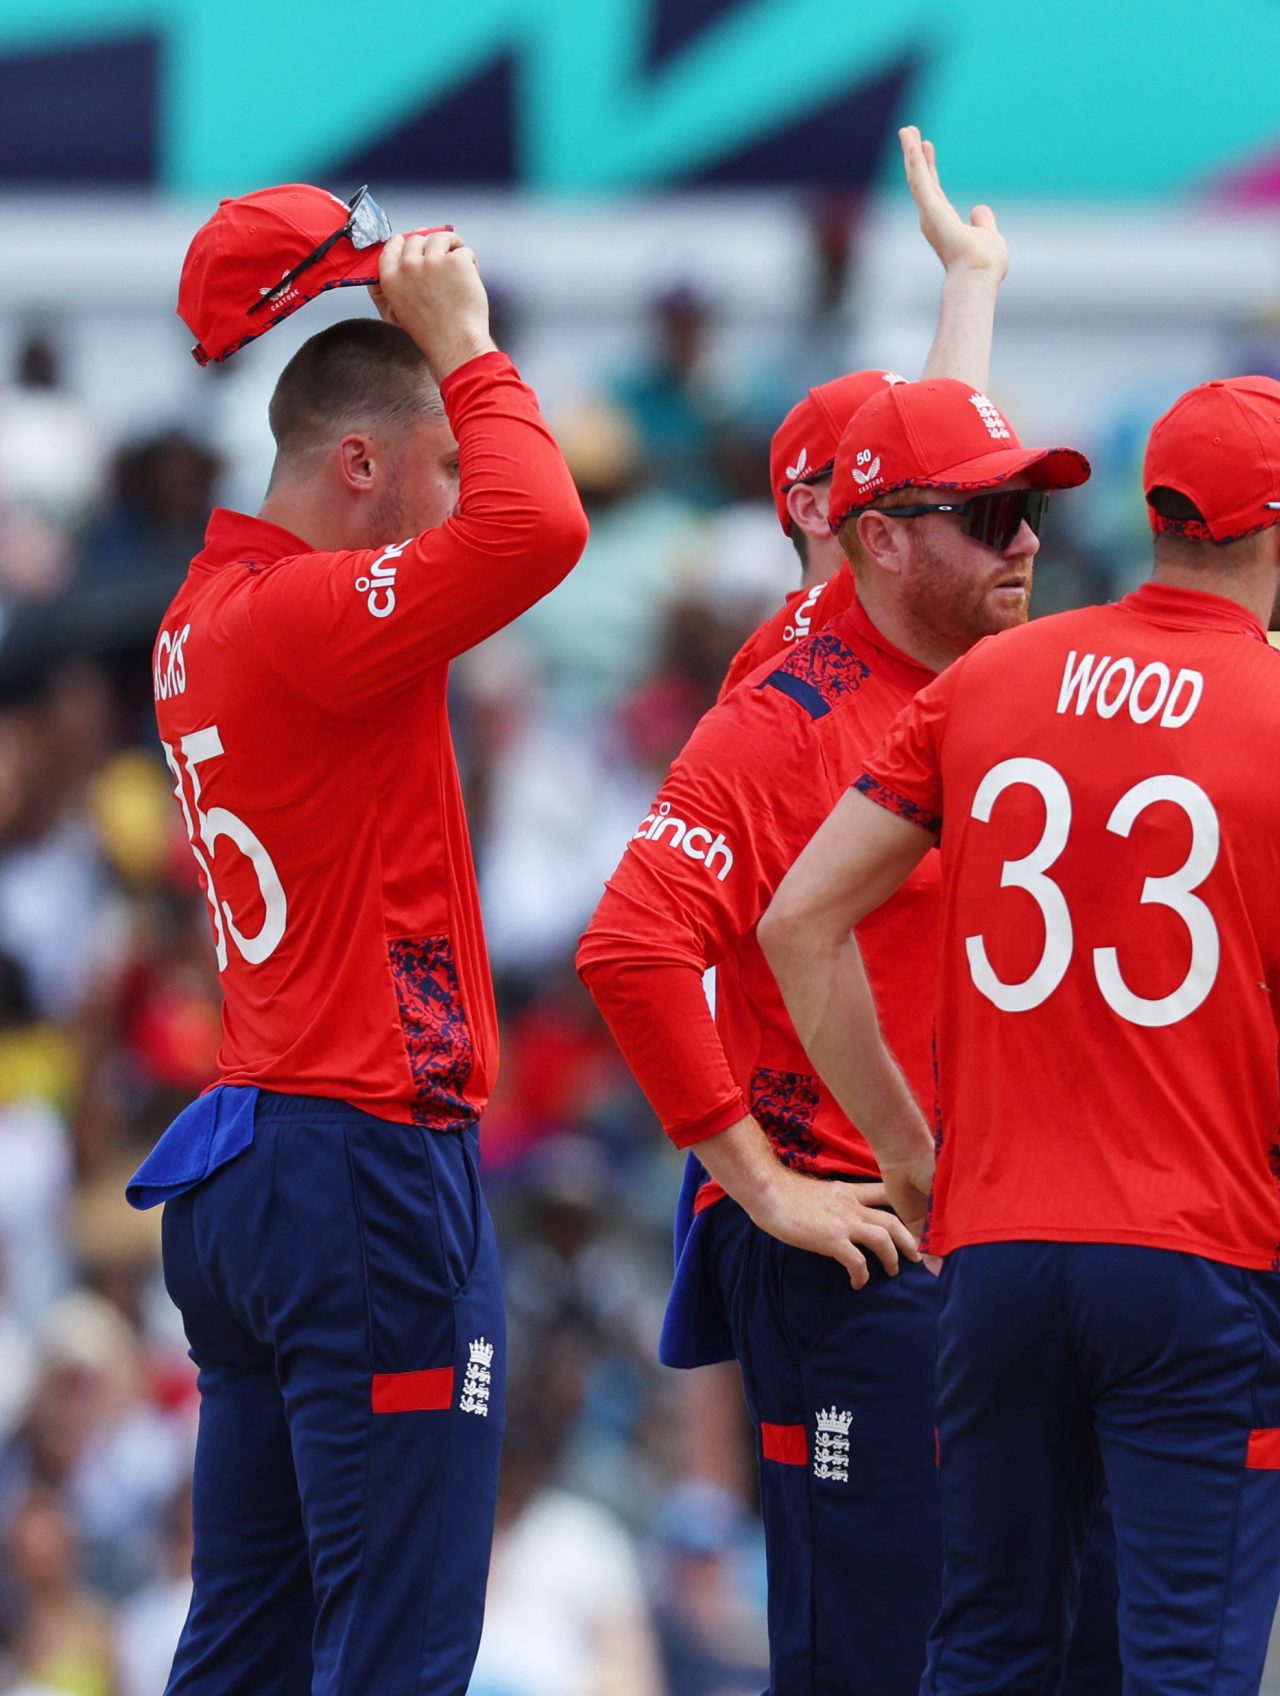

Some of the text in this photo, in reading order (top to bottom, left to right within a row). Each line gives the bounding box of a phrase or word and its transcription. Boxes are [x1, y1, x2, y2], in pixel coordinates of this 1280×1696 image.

[270, 289, 299, 311] CASTORE
[857, 449, 871, 466] 50
[1056, 650, 1204, 729] WOOD
[632, 801, 734, 882] cinch
[965, 756, 1221, 1028] 33
